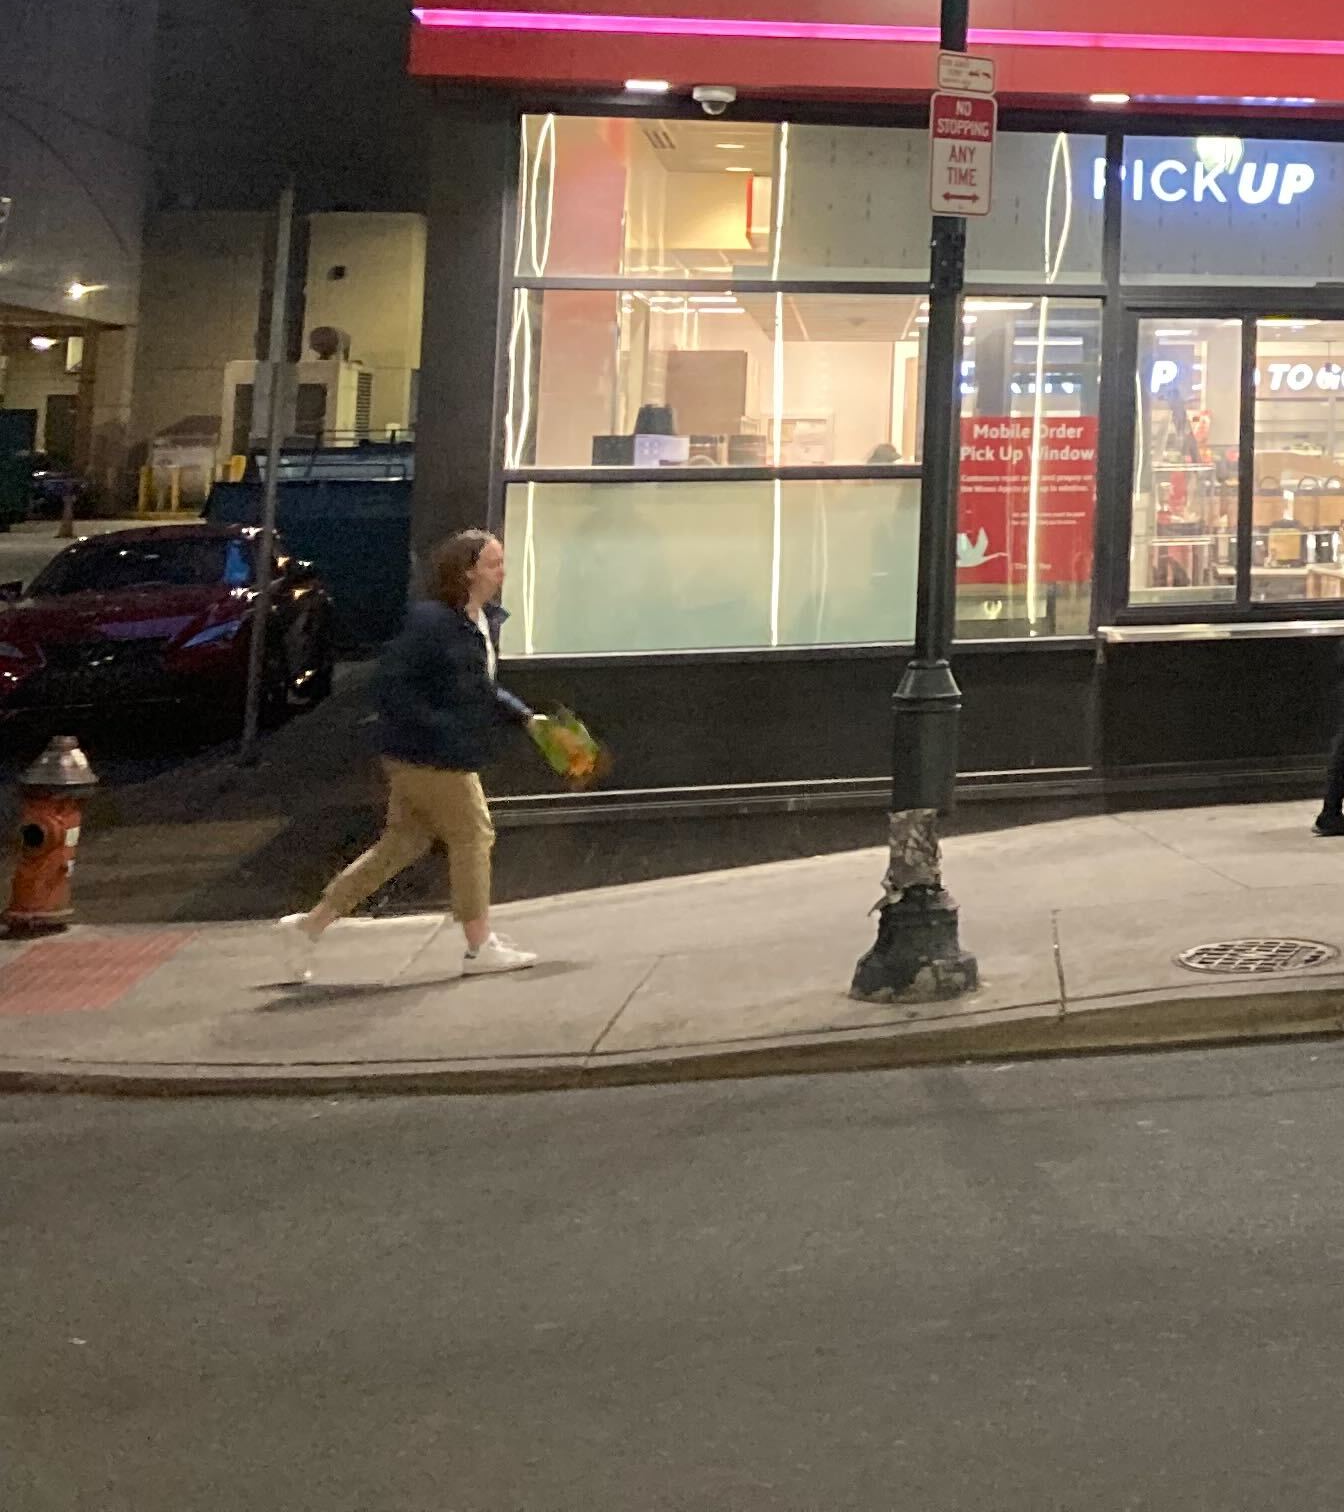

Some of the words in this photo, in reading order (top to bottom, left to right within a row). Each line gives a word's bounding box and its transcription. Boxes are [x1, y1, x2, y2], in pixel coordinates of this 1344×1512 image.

[955, 100, 973, 117] NO
[937, 118, 990, 137] STOPPING
[948, 144, 976, 163] ANY
[946, 166, 977, 187] TIME
[973, 423, 1030, 439] Mobile
[1037, 423, 1084, 439] Order
[960, 446, 994, 462] Pick
[1000, 446, 1023, 464] Up
